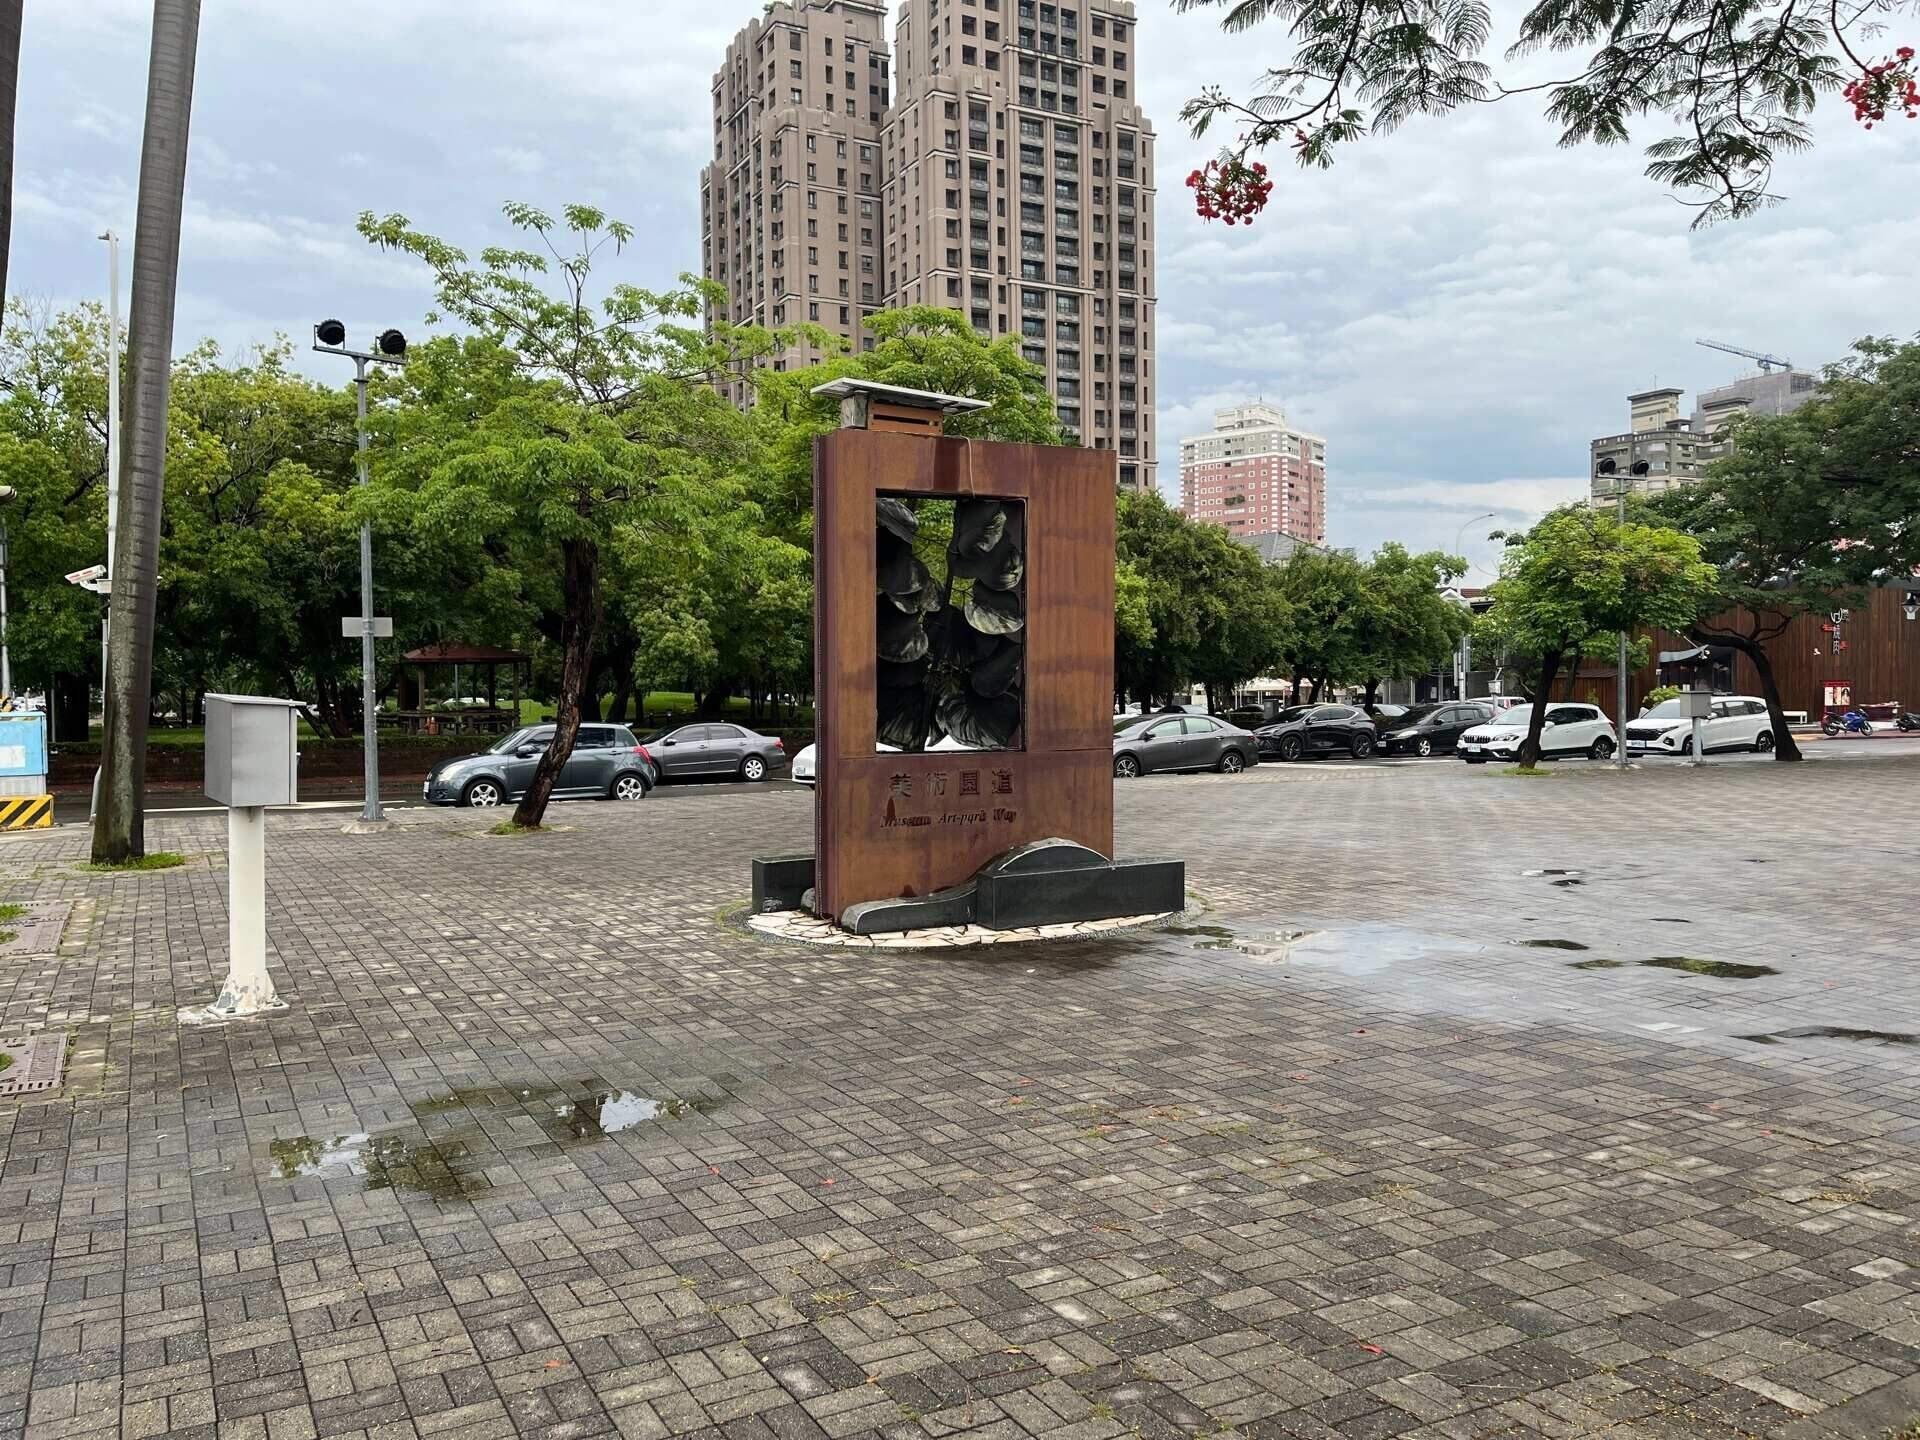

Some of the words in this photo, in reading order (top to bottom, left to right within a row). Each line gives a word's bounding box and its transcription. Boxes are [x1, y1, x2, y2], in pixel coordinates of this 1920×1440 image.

[889, 769, 1013, 798] 美術園道
[993, 807, 1016, 823] Way
